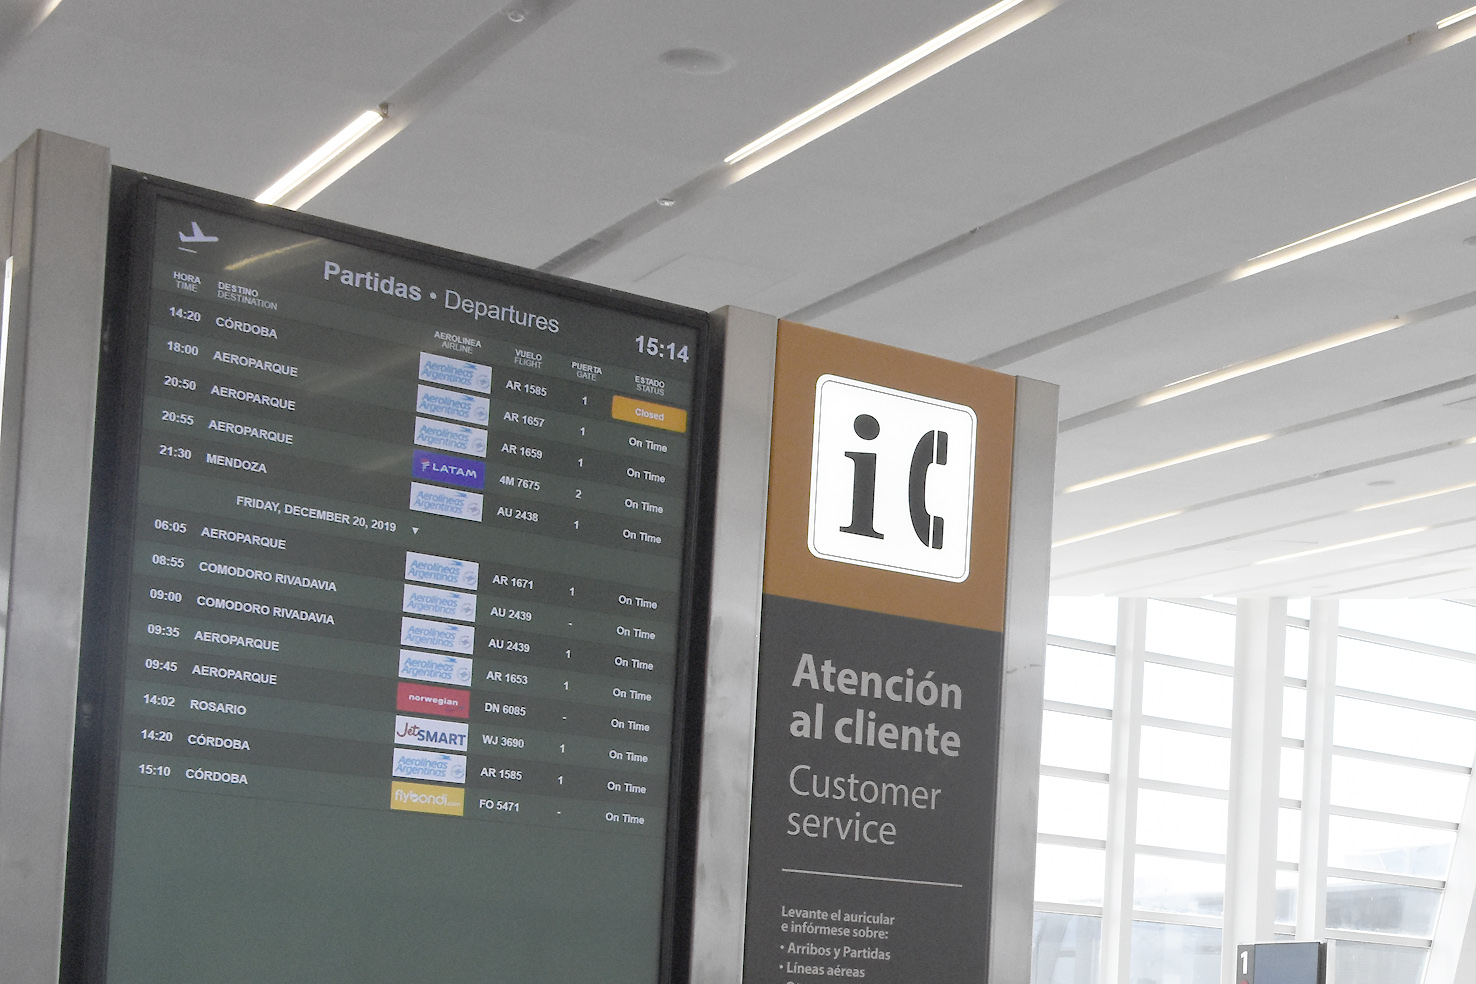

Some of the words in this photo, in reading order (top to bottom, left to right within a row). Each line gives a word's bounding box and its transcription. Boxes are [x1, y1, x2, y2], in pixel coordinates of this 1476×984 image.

[173, 271, 202, 284] HORA
[176, 281, 198, 293] TIME
[218, 282, 259, 297] DESTINO
[217, 290, 278, 310] DESTINATION
[324, 261, 422, 301] Partidas
[445, 289, 560, 333] Departures
[169, 306, 201, 322] 14:20
[215, 317, 278, 339] CÓRDOBA
[441, 341, 473, 354] AIRLINE
[514, 348, 543, 361] VUELO
[635, 335, 690, 363] 15:14
[167, 341, 199, 356] 18:00
[213, 350, 298, 377] AEROPARQUE
[514, 357, 543, 369] FLIGHT
[571, 361, 603, 375] PUERTA
[576, 371, 597, 382] GATE
[635, 375, 665, 388] ESTADO
[164, 375, 197, 391] 20:50
[210, 385, 296, 411] AEROPARQUE
[505, 380, 521, 391] AR
[524, 384, 547, 396] 1585
[636, 384, 665, 396] STATUS
[582, 396, 588, 406] 1
[503, 412, 519, 422] AR
[522, 416, 545, 428] 1657
[635, 408, 665, 421] Closed
[161, 410, 194, 425] 20:55
[208, 419, 293, 445] AEROPARQUE
[501, 443, 517, 454] AR
[520, 447, 543, 459] 1659
[628, 437, 643, 448] On
[645, 439, 668, 453] Time
[159, 444, 192, 460] 21:30
[206, 453, 267, 474] MENDOZA
[432, 463, 477, 479] LATAM
[626, 468, 641, 478] On
[643, 470, 666, 483] Time
[499, 475, 514, 486] 4M
[517, 478, 540, 491] 7675
[575, 489, 582, 499] 2
[236, 495, 281, 515] FRIDAY,
[284, 504, 350, 525] DECEMBER
[353, 516, 368, 529] 20,
[371, 519, 397, 532] 2019
[497, 507, 512, 517] AU
[515, 510, 539, 522] 2438
[624, 499, 639, 509] On
[641, 501, 664, 514] Time
[154, 519, 187, 534] 06:05
[201, 527, 287, 550] AEROPARQUE
[152, 554, 185, 568] 08:55
[199, 561, 272, 582] COMODORO
[275, 573, 337, 592] RIVADAVIA
[492, 575, 508, 586] AR
[511, 577, 534, 589] 1671
[149, 588, 183, 602] 09:00
[196, 595, 270, 615] COMODORO
[273, 607, 335, 625] RIVADAVIA
[618, 595, 632, 605] On
[635, 597, 658, 609] Time
[490, 607, 506, 617] AU
[508, 609, 532, 621] 2439
[147, 623, 180, 637] 09:35
[194, 630, 280, 651] AEROPARQUE
[616, 626, 630, 636] On
[633, 628, 656, 640] Time
[488, 639, 504, 649] AU
[506, 641, 530, 653] 2439
[145, 658, 178, 672] 09:45
[192, 664, 277, 685] AEROPARQUE
[486, 671, 502, 681] AR
[504, 673, 528, 684] 1653
[792, 653, 963, 709] Atención
[408, 694, 459, 706] norwegian
[612, 688, 626, 698] On
[629, 690, 652, 701] Time
[143, 693, 176, 707] 14:02
[190, 699, 247, 716] ROSARIO
[484, 702, 500, 713] DN
[502, 705, 526, 716] 6085
[610, 719, 625, 729] On
[627, 720, 650, 732] Time
[789, 702, 823, 740] al
[834, 709, 961, 757] cliente
[141, 729, 173, 742] 14:20
[187, 733, 250, 751] CÓRDOBA
[482, 734, 498, 745] WJ
[501, 737, 525, 748] 3690
[138, 763, 171, 777] 15:10
[185, 767, 248, 784] CÓRDOBA
[480, 767, 496, 778] AR
[499, 769, 523, 781] 1585
[788, 764, 942, 811] Customer
[479, 799, 494, 809] FO
[496, 801, 520, 812] 5471
[605, 812, 619, 822] On
[622, 813, 645, 825] Time
[786, 810, 897, 846] service
[781, 905, 828, 921] Levante
[830, 909, 842, 921] el
[843, 913, 895, 925] auricular
[781, 922, 788, 932] e
[791, 921, 850, 937] infórmese
[852, 927, 889, 939] sobre:
[787, 942, 831, 957] Arribos
[834, 947, 841, 959] y
[843, 946, 891, 960] Partidas
[786, 961, 825, 976] Líneas
[827, 964, 865, 978] aéreas
[1240, 950, 1249, 975] 1
